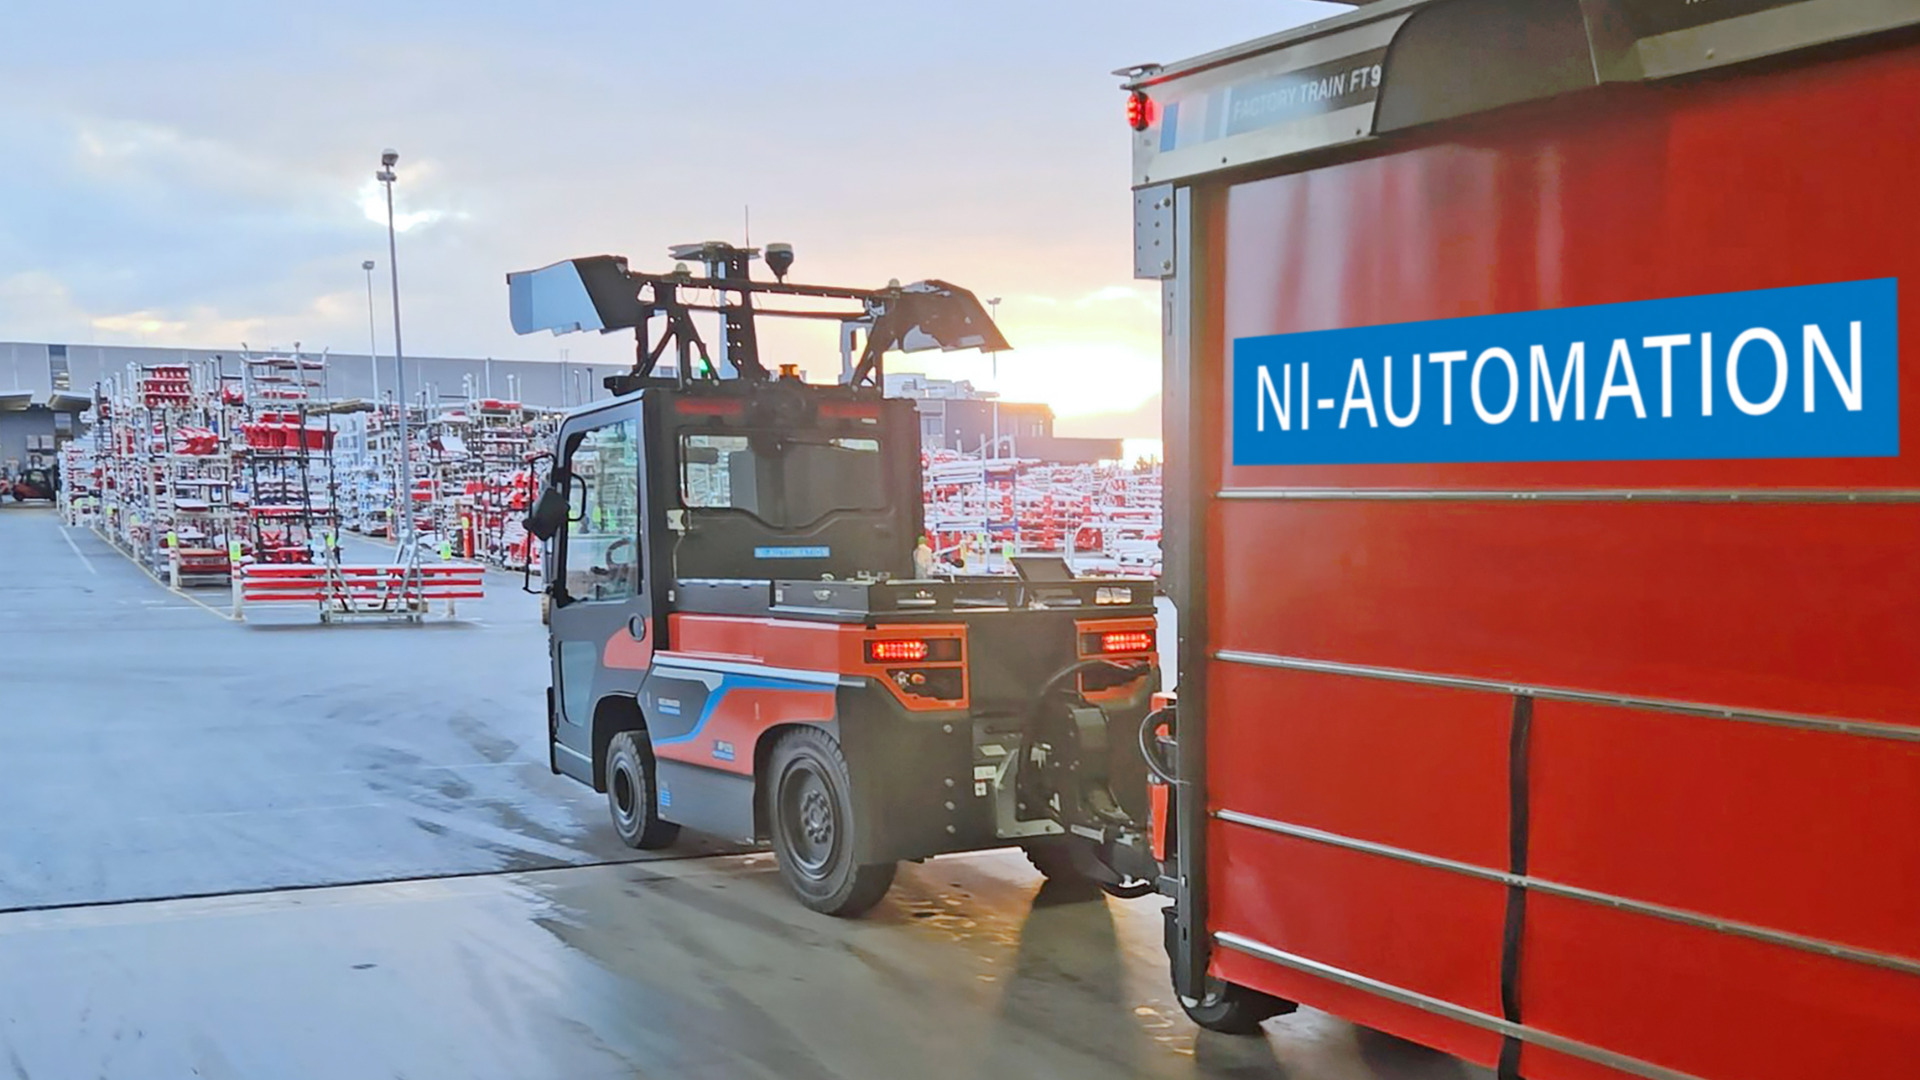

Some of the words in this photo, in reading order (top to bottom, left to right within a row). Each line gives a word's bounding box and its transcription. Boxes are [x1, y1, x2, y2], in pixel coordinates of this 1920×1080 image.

[1233, 87, 1297, 121] FACTORY
[1301, 73, 1346, 103] TRAIN
[1257, 320, 1864, 432] NI-AUTOMATION
